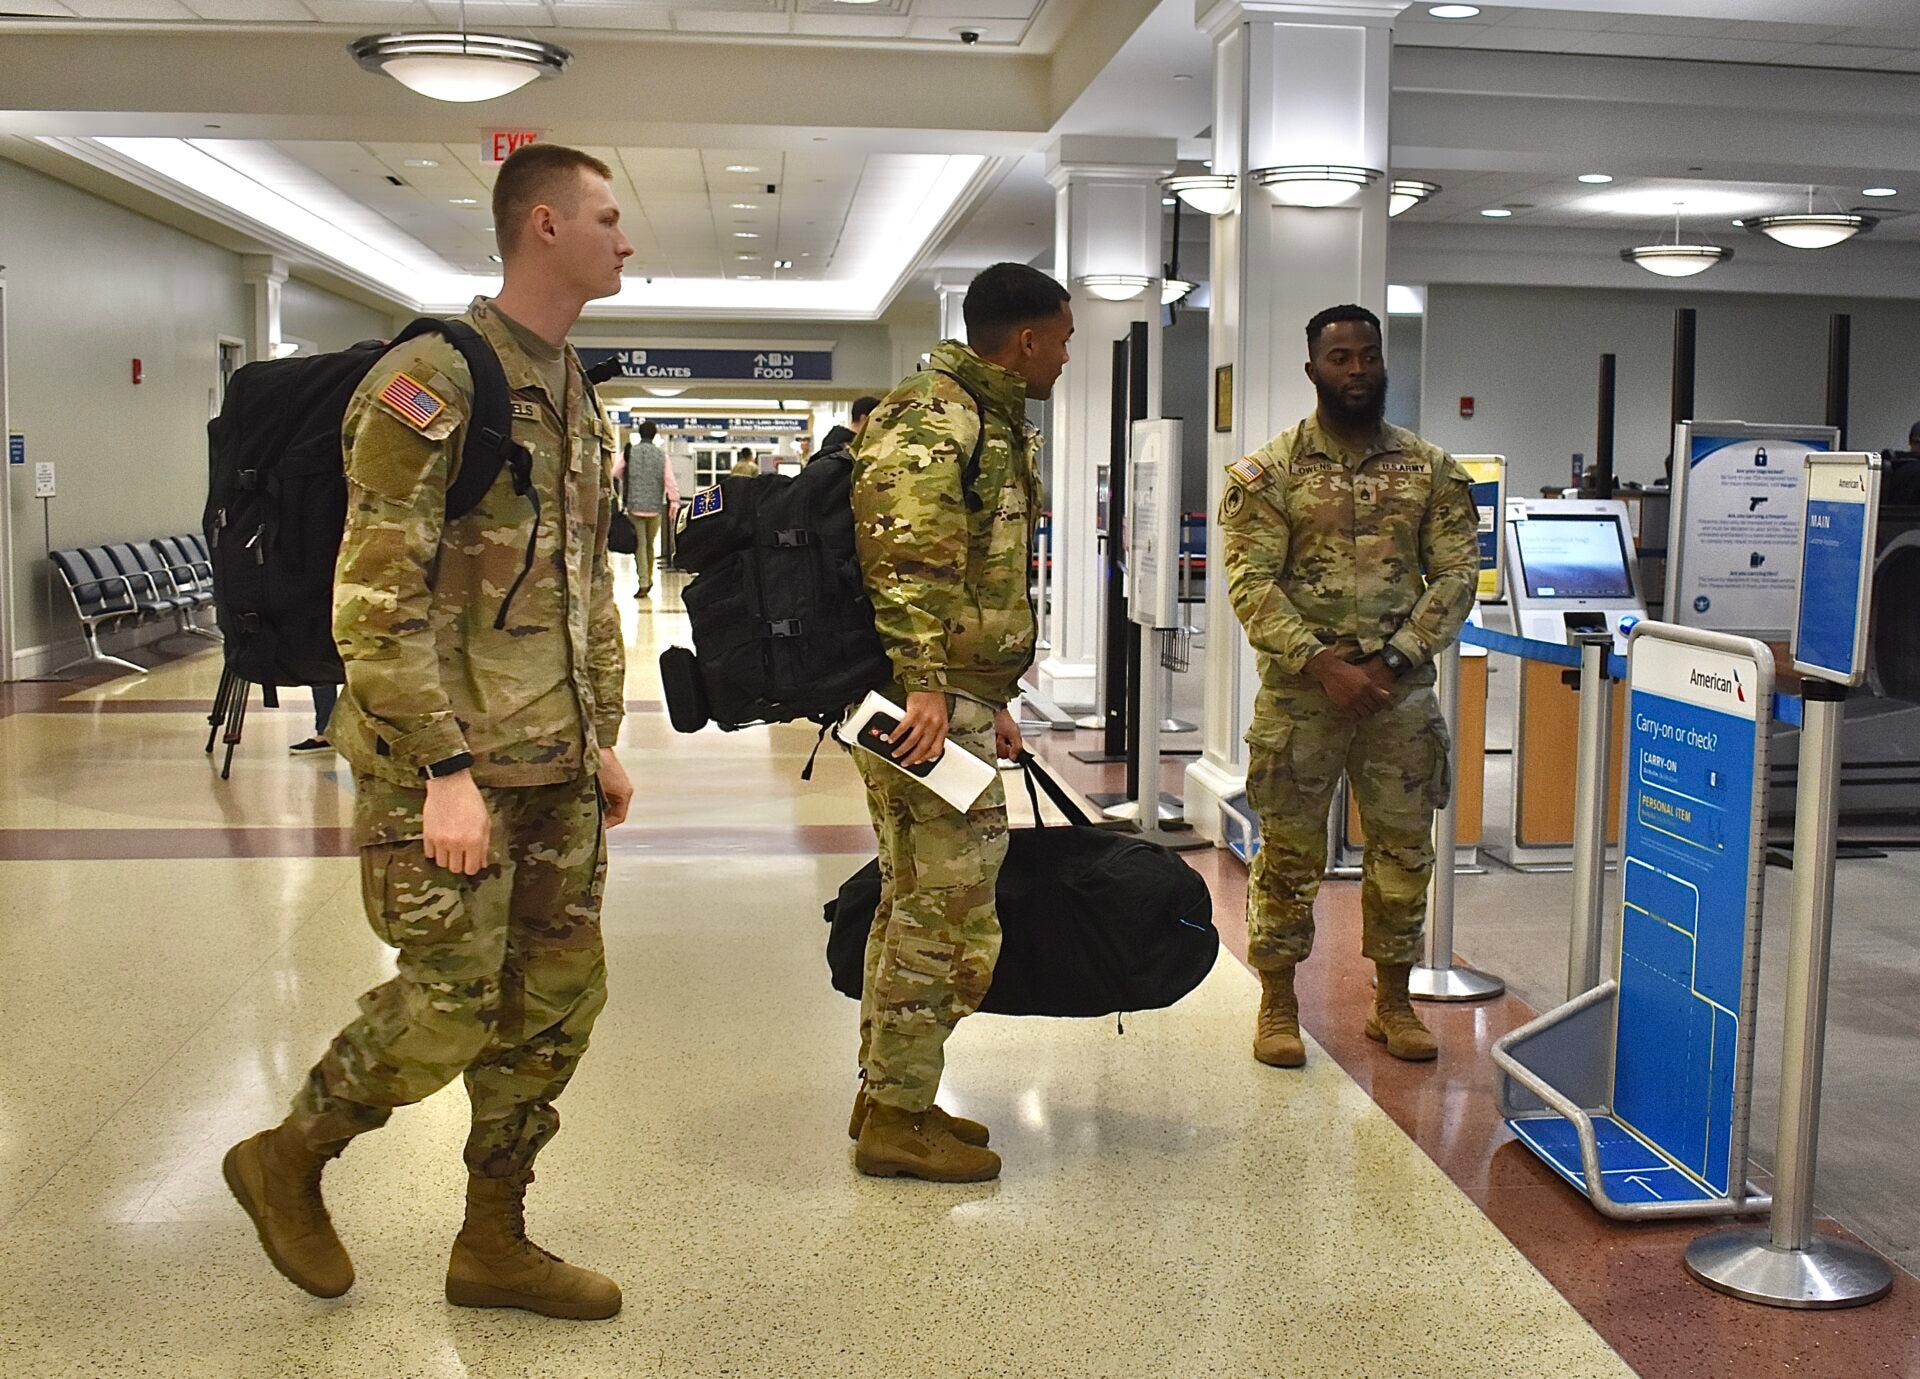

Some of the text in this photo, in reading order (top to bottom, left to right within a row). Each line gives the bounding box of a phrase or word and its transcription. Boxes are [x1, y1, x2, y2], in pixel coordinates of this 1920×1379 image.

[621, 365, 692, 378] ALL GATES
[754, 367, 794, 379] FOOD
[1298, 463, 1332, 474] OWENS
[1839, 479, 1859, 488] American
[1811, 514, 1831, 529] MAIN
[1689, 668, 1732, 694] American
[1636, 712, 1718, 752] Carry-on or check?
[1643, 752, 1678, 773] CARRY-ON
[1642, 795, 1674, 817] PERSONAL
[1675, 807, 1692, 823] ITEM
